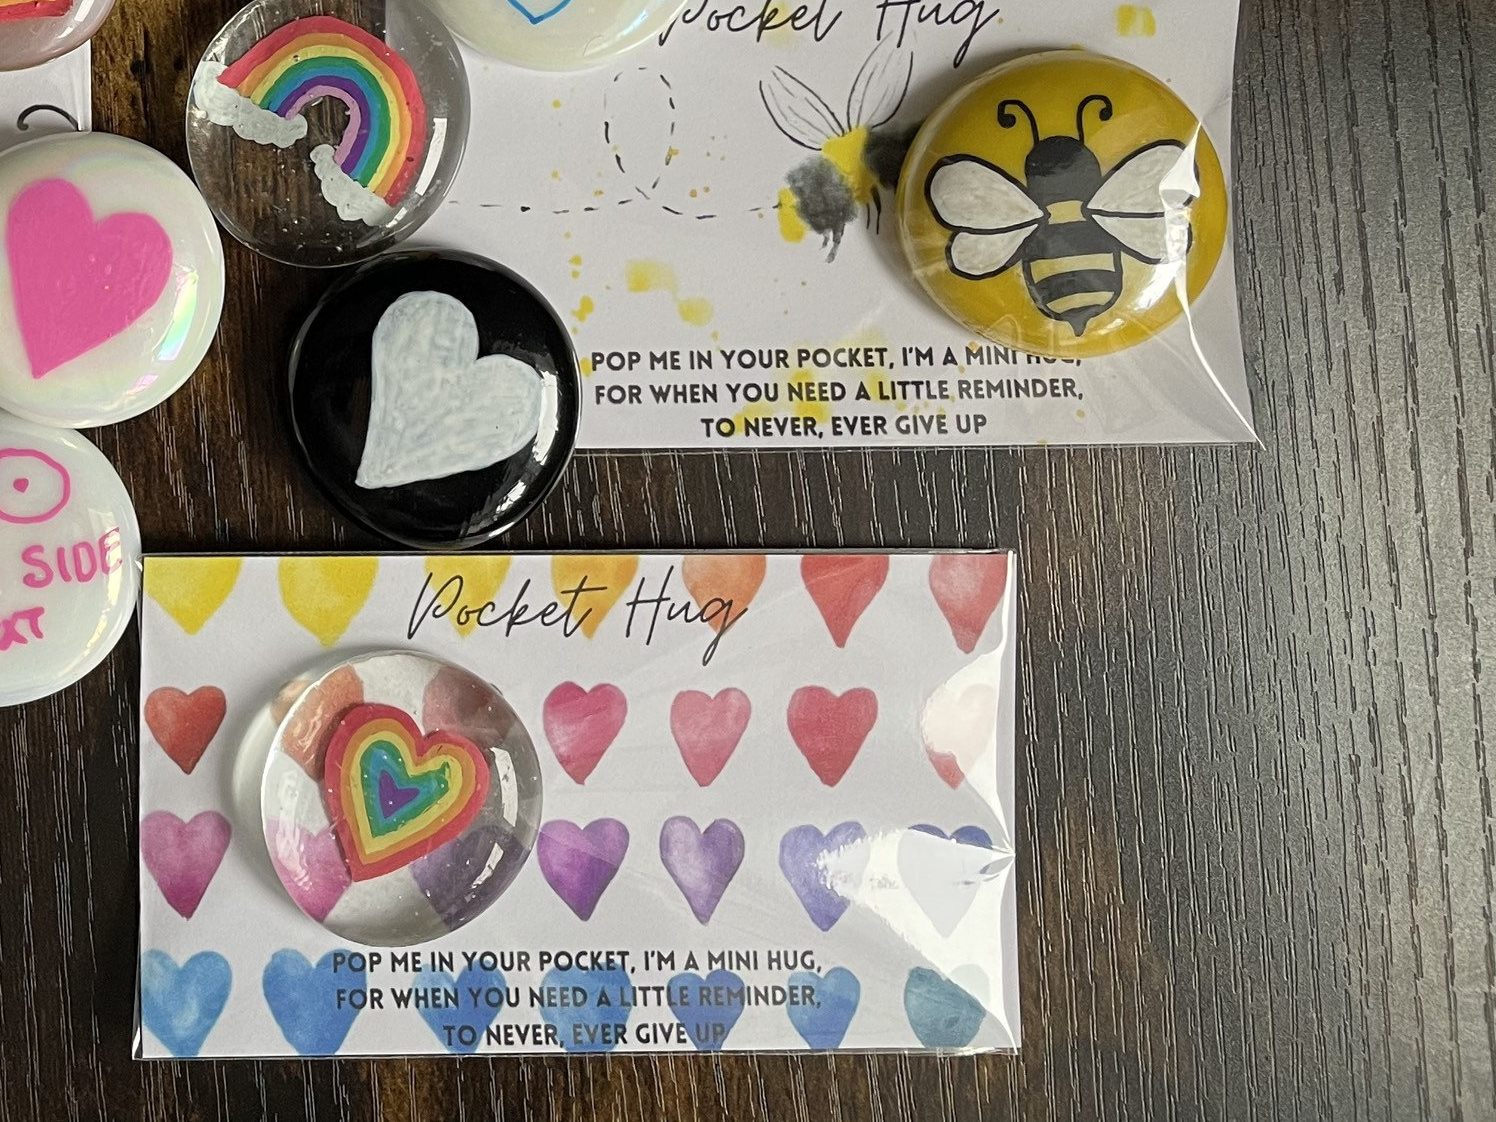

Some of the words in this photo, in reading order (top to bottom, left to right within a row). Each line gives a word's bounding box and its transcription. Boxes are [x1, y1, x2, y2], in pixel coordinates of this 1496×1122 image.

[591, 351, 641, 371] POP
[649, 350, 681, 370] ME
[689, 349, 712, 370] IN
[719, 348, 789, 369] YOUR
[797, 346, 894, 369] POCKET,
[901, 346, 934, 366] I'M
[942, 346, 958, 366] A
[594, 384, 642, 405] FOR
[648, 383, 717, 404] WHEN
[725, 382, 778, 403] YOU
[787, 381, 846, 401] NEED
[854, 380, 871, 400] A
[877, 379, 949, 400] LITTLE
[957, 377, 1083, 400] REMINDER,
[700, 417, 735, 437] TO
[743, 416, 823, 439] NEVER,
[831, 415, 887, 436] EVER
[894, 413, 948, 435] GIVE
[955, 413, 986, 434] UP
[21, 526, 123, 589] SIDE
[406, 571, 608, 640] Pocket
[624, 564, 750, 666] Hug
[332, 951, 381, 973] POP
[390, 951, 422, 972] ME
[430, 951, 454, 972] IN
[461, 950, 530, 971] YOUR
[538, 950, 635, 974] POCKET,
[643, 949, 675, 971] I'M
[684, 950, 699, 970] A
[707, 949, 758, 970] MINI
[767, 949, 821, 973] HUG,
